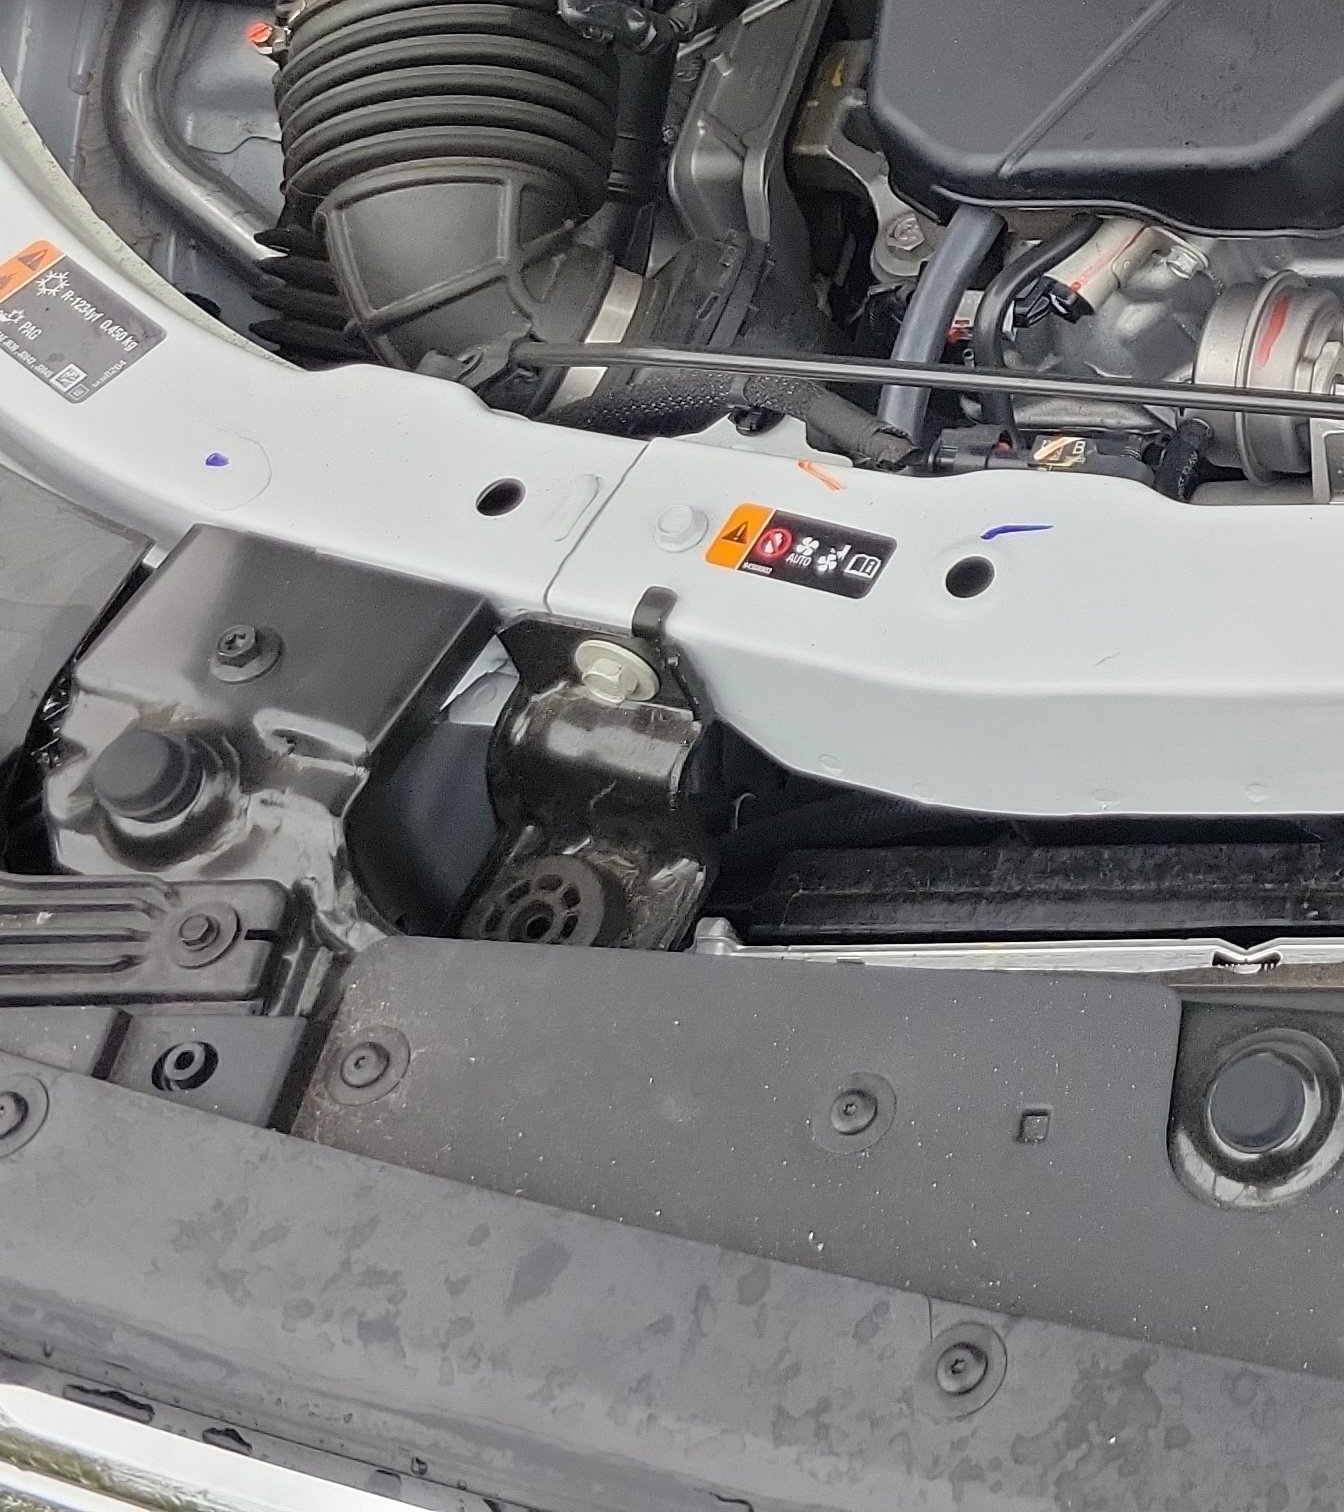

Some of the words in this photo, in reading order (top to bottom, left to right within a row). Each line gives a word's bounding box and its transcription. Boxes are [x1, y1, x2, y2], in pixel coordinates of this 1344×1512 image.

[18, 321, 42, 341] PAG
[122, 337, 139, 352] kg
[785, 552, 813, 568] AUTO
